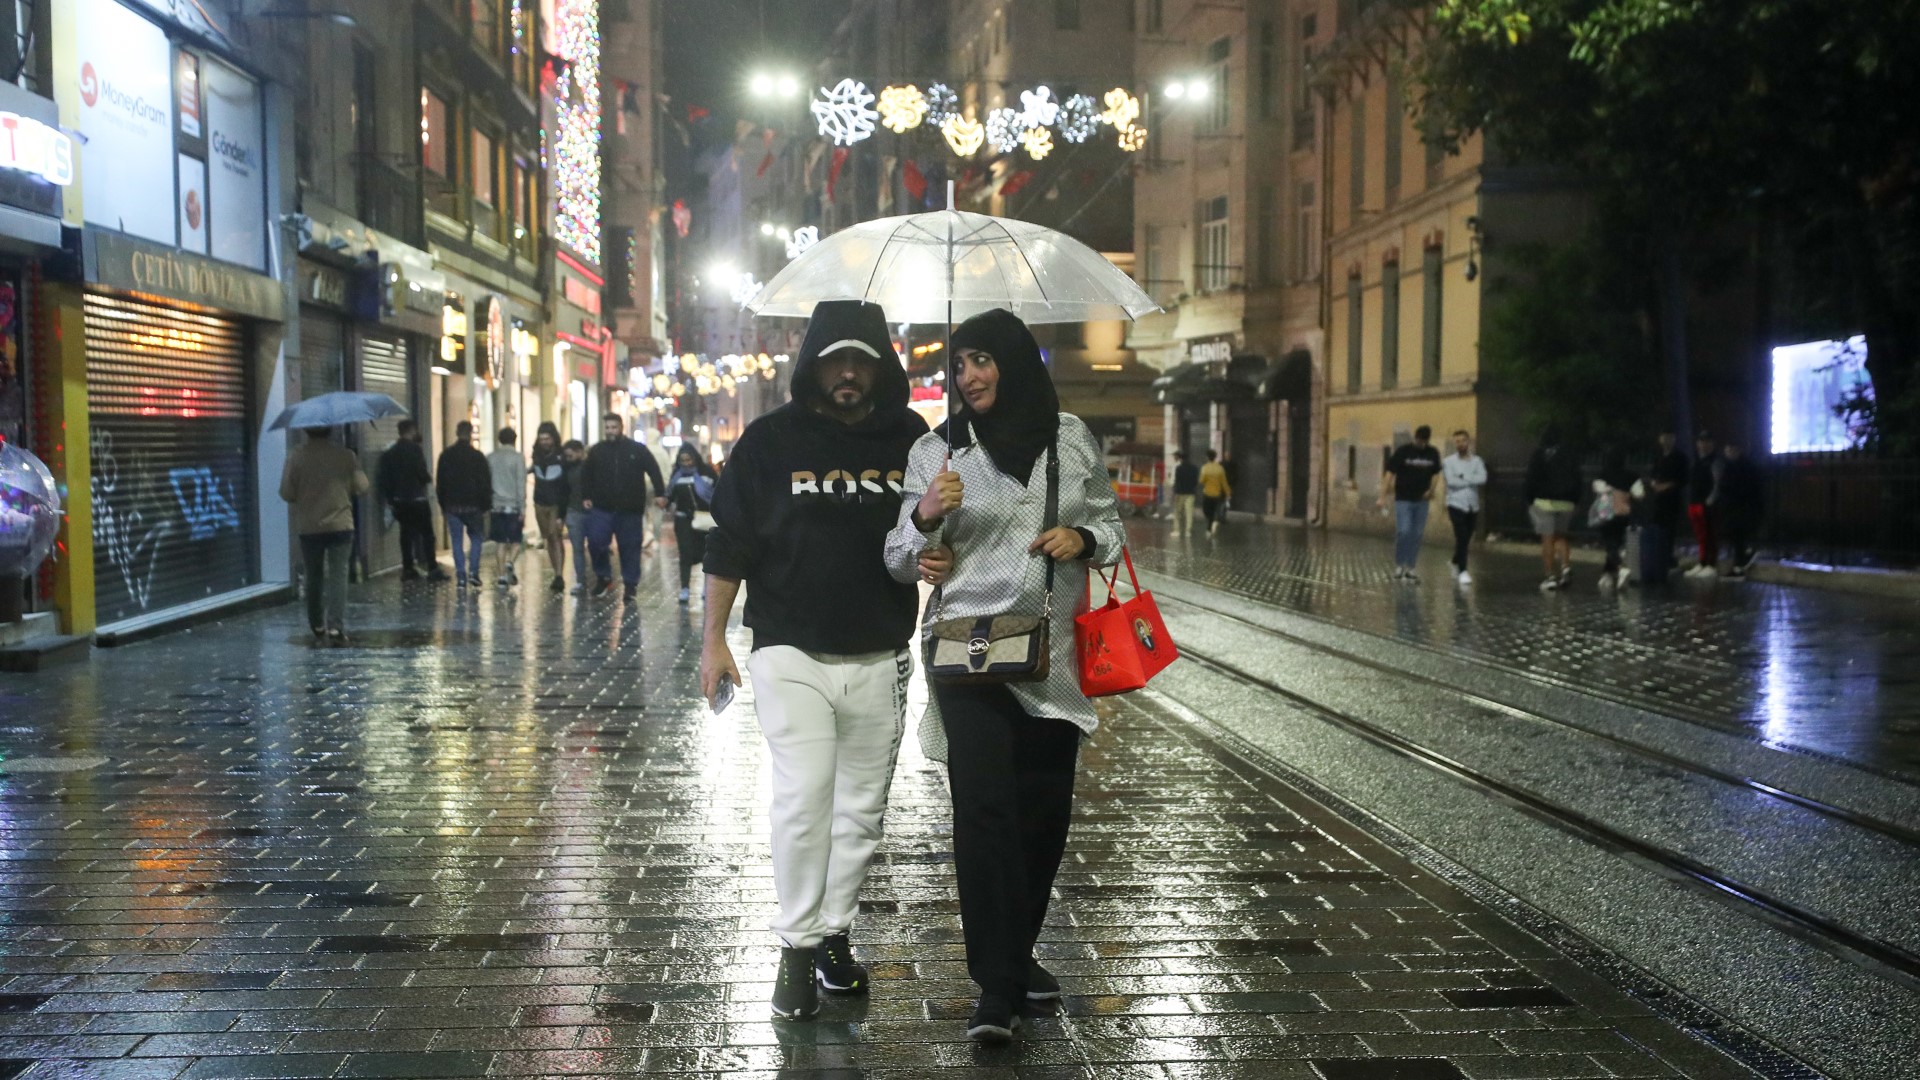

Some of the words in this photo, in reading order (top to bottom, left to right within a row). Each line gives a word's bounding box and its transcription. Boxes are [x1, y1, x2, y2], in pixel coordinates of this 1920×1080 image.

[101, 78, 167, 128] MoneyGram
[2, 117, 69, 179] TYS
[131, 250, 185, 291] ÇETİN
